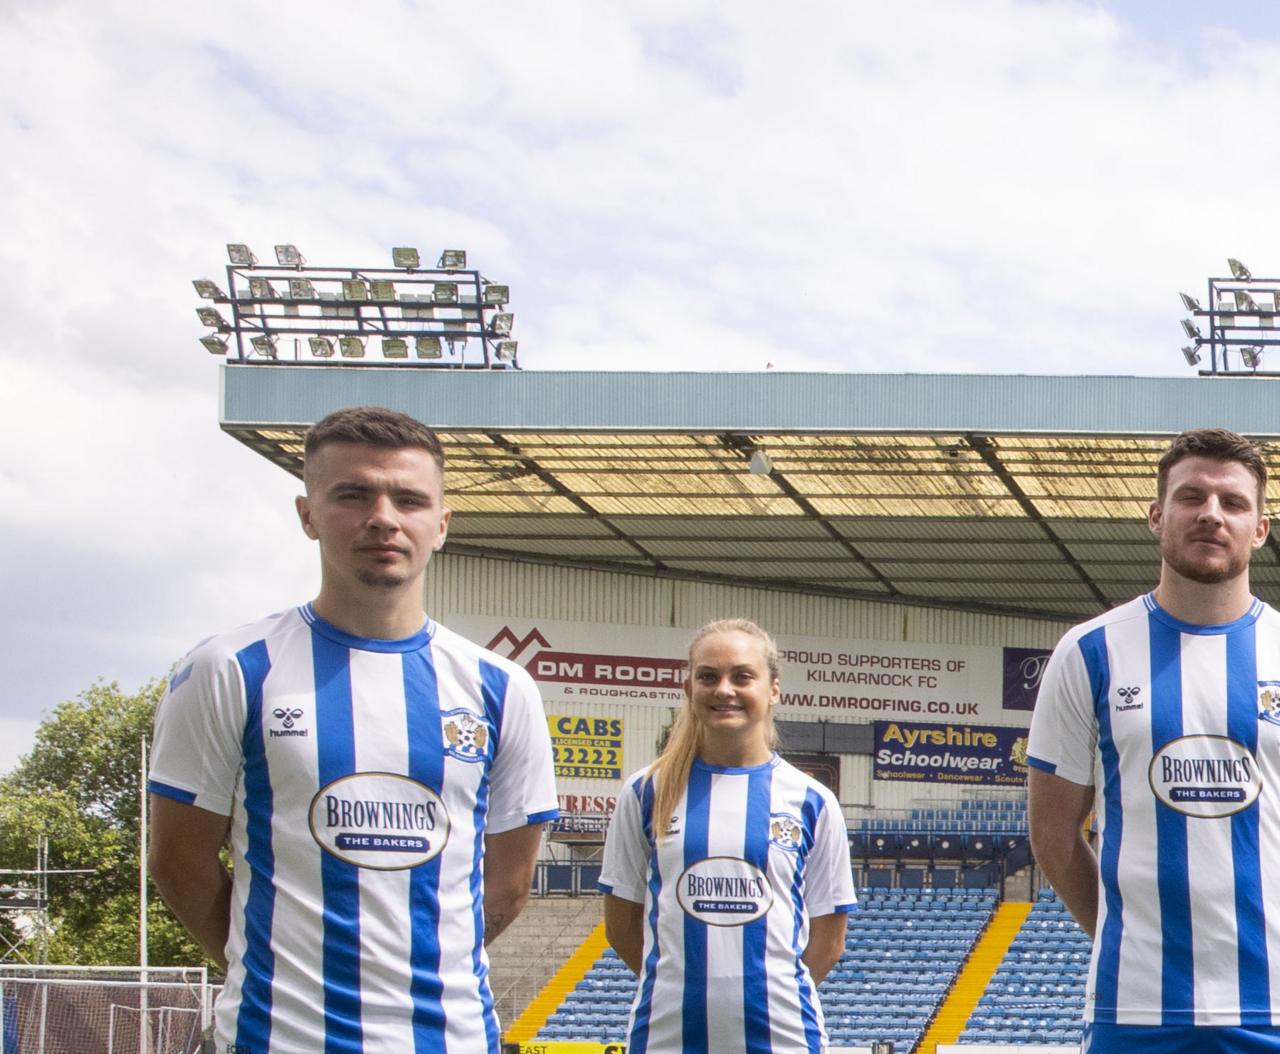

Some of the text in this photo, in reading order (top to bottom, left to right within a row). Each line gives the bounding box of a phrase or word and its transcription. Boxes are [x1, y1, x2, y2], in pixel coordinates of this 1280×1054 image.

[537, 660, 583, 679] DM
[837, 653, 942, 671] SUPPORTERS
[946, 660, 967, 673] OF
[806, 669, 938, 689] KILMARNOCK FC
[563, 686, 685, 701] & ROUGHCASTIN
[1115, 702, 1144, 713] hummel
[269, 727, 309, 737] hummel
[557, 717, 622, 737] CABS
[882, 723, 998, 748] Ayrshire
[876, 749, 1002, 771] Schoolwear
[1161, 754, 1252, 784] BROWNINGS
[875, 769, 926, 780] Schoolwear
[937, 772, 984, 782] Dancewear
[1175, 789, 1242, 799] THE BAKERS
[325, 794, 437, 832] BROWNINGS
[343, 836, 424, 848] THE BAKERS
[686, 873, 764, 899] BROWNINGS
[697, 902, 754, 911] THE BAKERS
